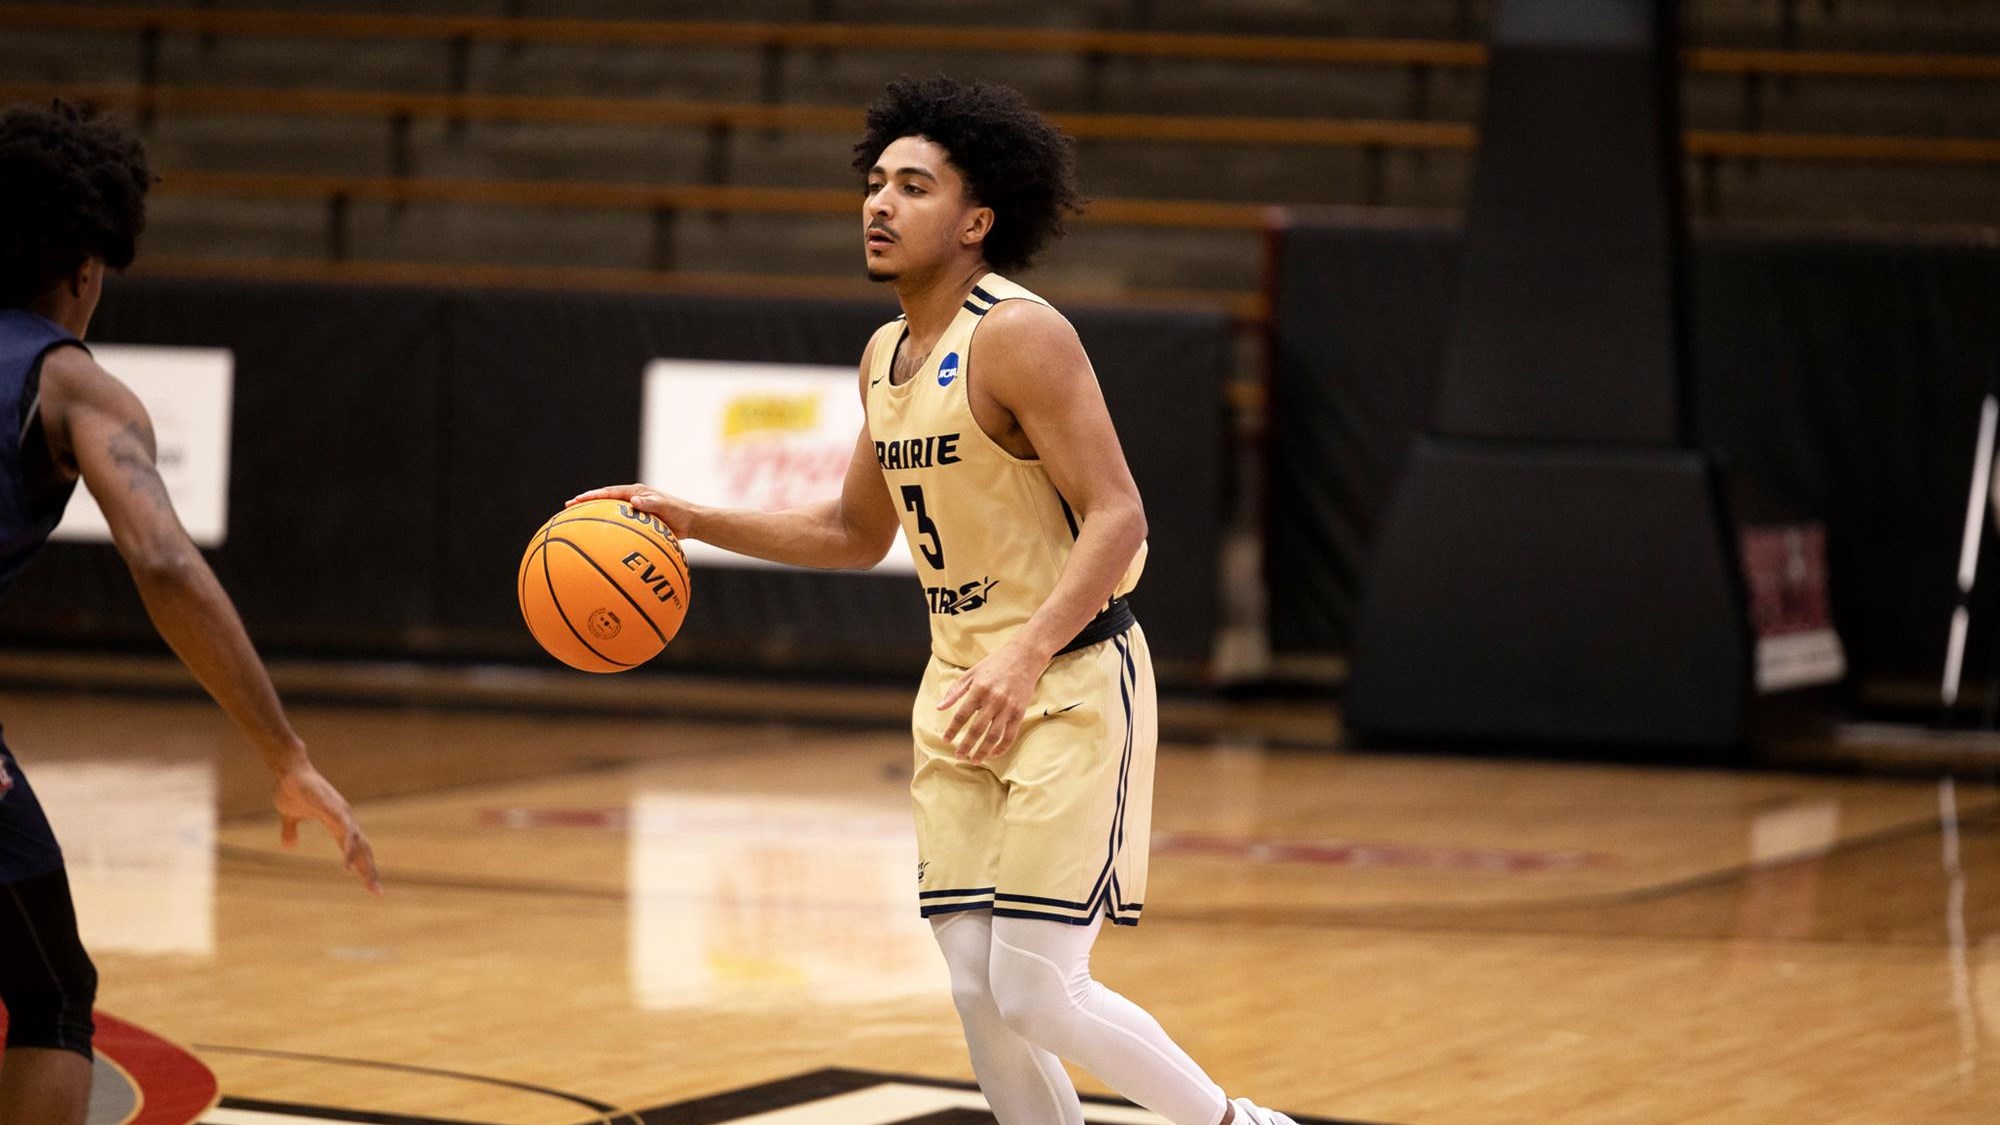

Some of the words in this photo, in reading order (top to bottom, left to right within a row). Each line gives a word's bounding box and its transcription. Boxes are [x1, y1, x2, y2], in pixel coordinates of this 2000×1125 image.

[872, 433, 962, 469] RAIRIE
[900, 485, 944, 570] 3
[622, 551, 675, 602] EVO
[923, 577, 999, 615] TARS
